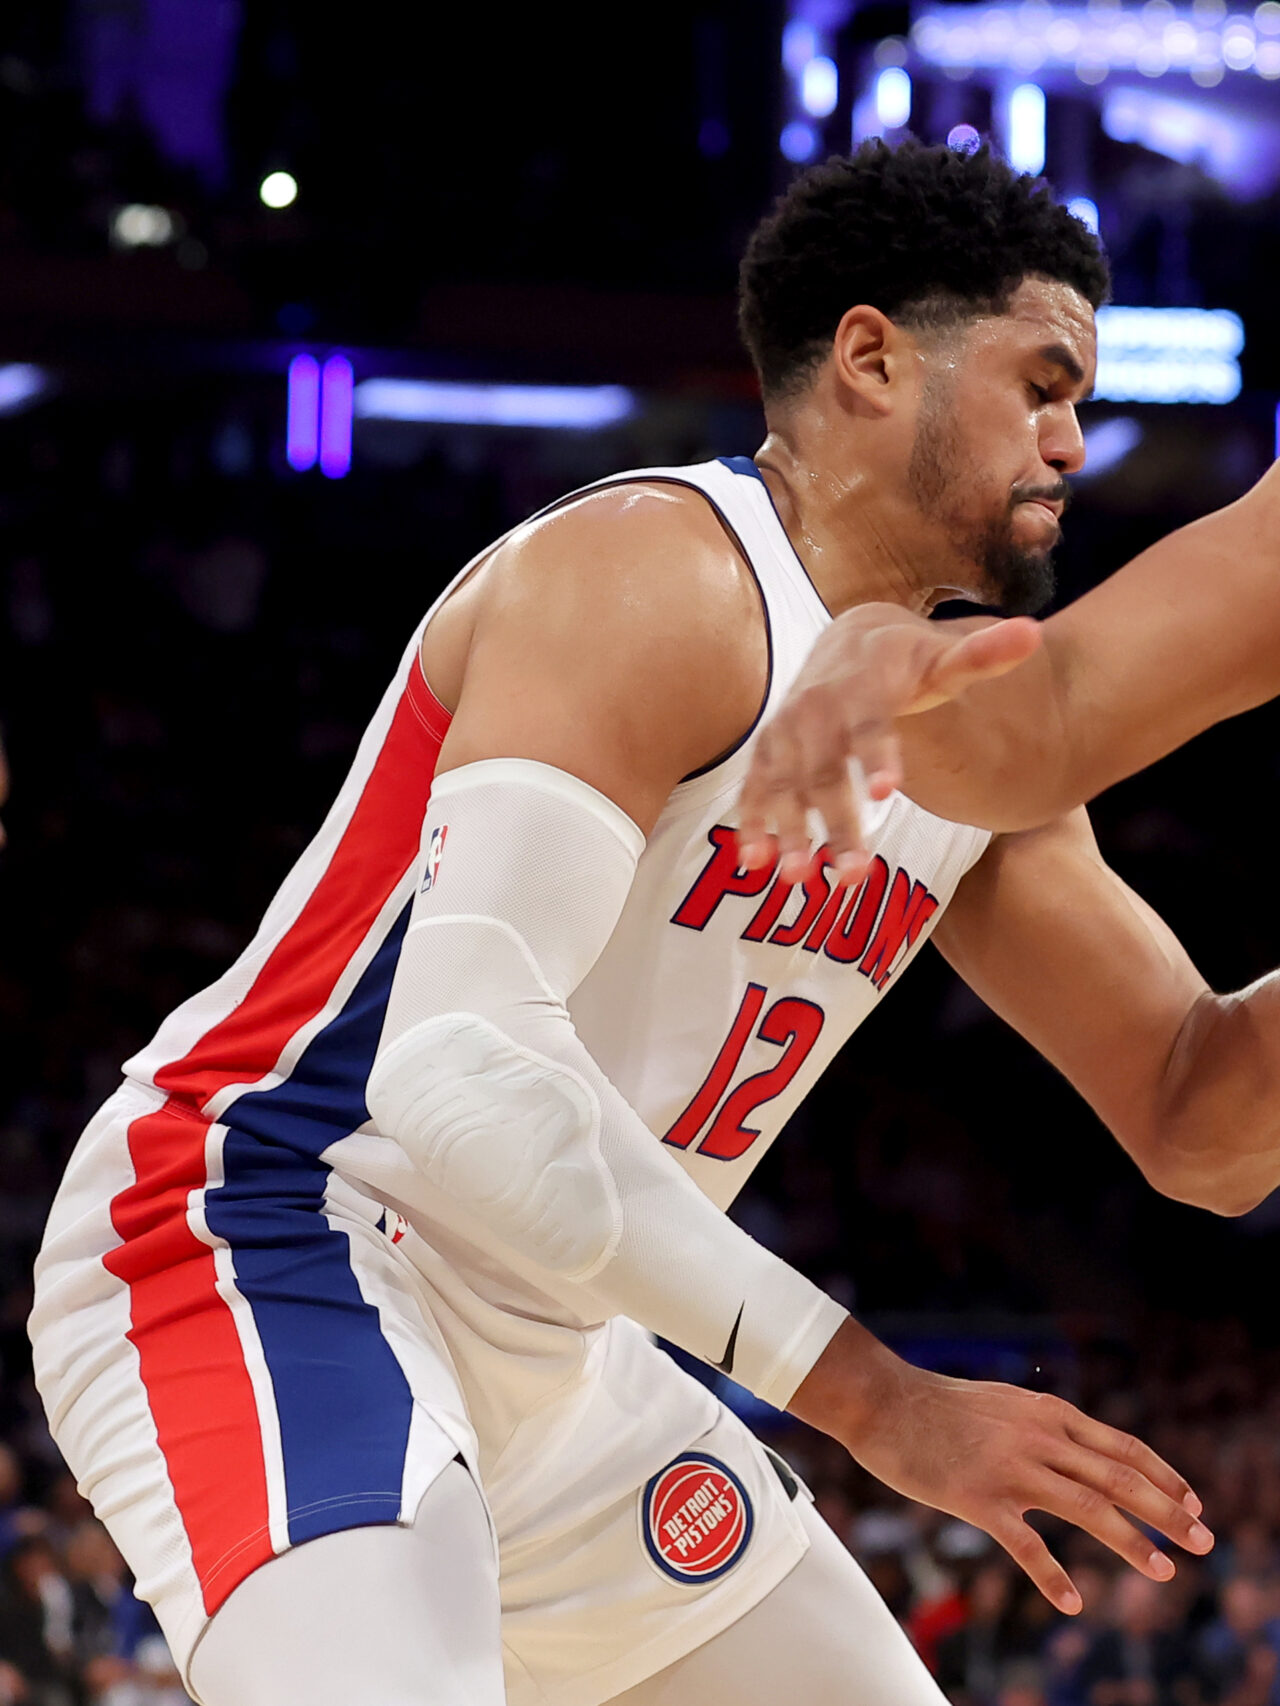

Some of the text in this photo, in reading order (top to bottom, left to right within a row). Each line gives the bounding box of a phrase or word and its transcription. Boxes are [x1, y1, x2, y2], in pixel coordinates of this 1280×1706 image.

[661, 982, 826, 1161] 12
[662, 1478, 719, 1540] DETROIT
[673, 1493, 733, 1557] PISTONS
